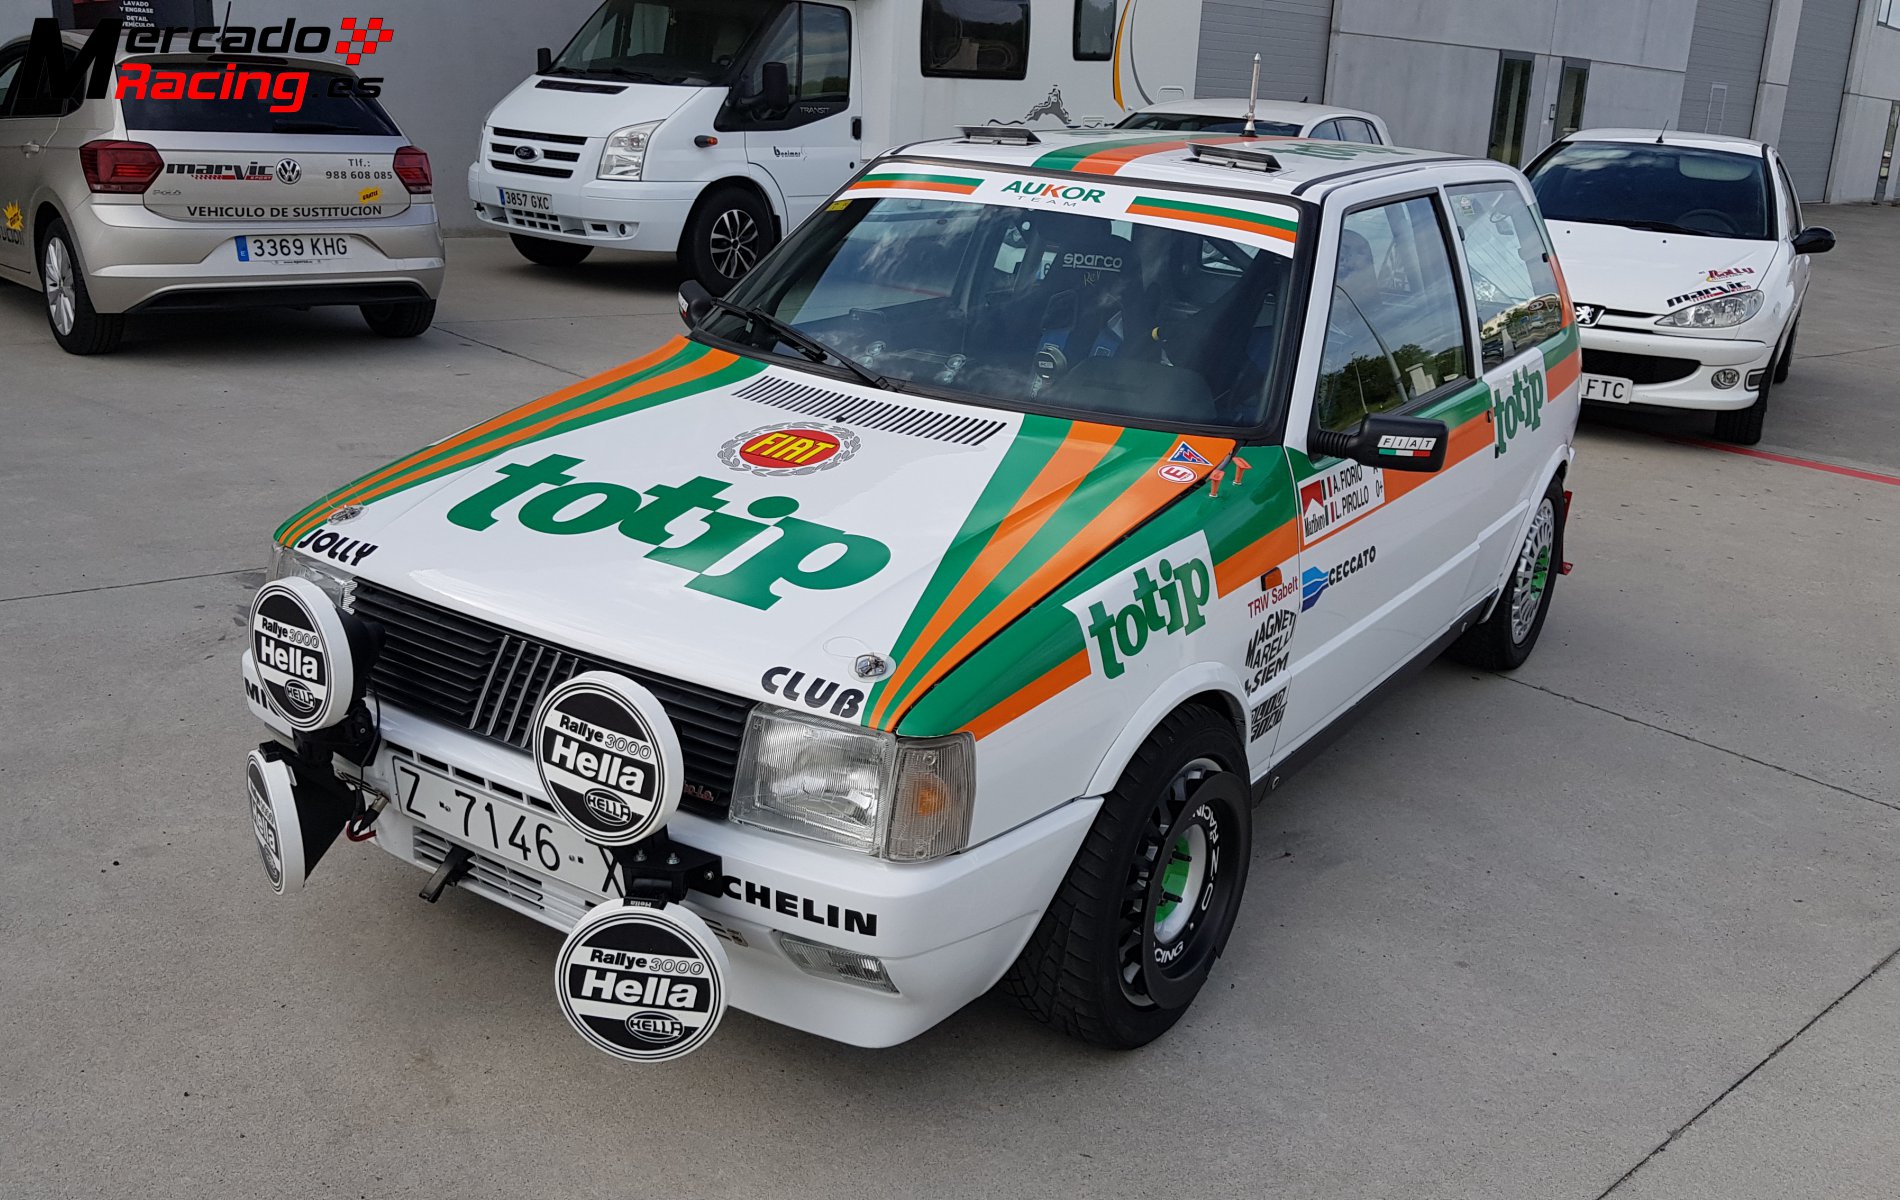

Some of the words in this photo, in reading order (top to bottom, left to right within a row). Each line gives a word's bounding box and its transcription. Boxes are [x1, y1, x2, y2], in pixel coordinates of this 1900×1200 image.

[166, 161, 274, 180] marvic
[325, 170, 347, 180] 988
[350, 170, 371, 180] 608
[373, 171, 393, 180] 085
[505, 191, 528, 207] 3857
[530, 195, 550, 210] GXC
[1001, 180, 1106, 203] AUKOR
[1016, 195, 1078, 208] TEAM
[187, 205, 265, 217] VEHICULO
[270, 207, 288, 217] DE
[293, 205, 382, 217] SUSTITUCION
[252, 238, 305, 257] 3369
[310, 237, 348, 256] KHG
[1063, 253, 1123, 270] sparco
[1586, 379, 1625, 399] FTC
[1494, 365, 1544, 455] totip
[745, 432, 836, 464] FIAT
[1383, 438, 1432, 447] FIAT
[1340, 464, 1363, 490] FIORIO
[1342, 485, 1370, 516] PIROLLO
[446, 453, 892, 611] totip
[297, 529, 379, 567] JOLLY
[1328, 545, 1377, 586] CECCATO
[1247, 592, 1269, 619] TRW
[1271, 576, 1299, 605] Sabelt
[1088, 558, 1210, 680] totip
[261, 617, 289, 639] Rallye
[288, 629, 320, 649] 3000
[260, 636, 318, 681] Hella
[287, 686, 316, 707] HELLA
[761, 666, 865, 719] CLUB
[559, 714, 604, 743] Rallye
[604, 734, 652, 760] 3000
[551, 734, 645, 794] Hella
[588, 794, 631, 822] HELLA
[590, 948, 647, 969] Rallye
[649, 957, 705, 975] 3000
[1153, 942, 1184, 964] CING
[581, 968, 698, 1009] Hella
[630, 1018, 683, 1036] HELLA
